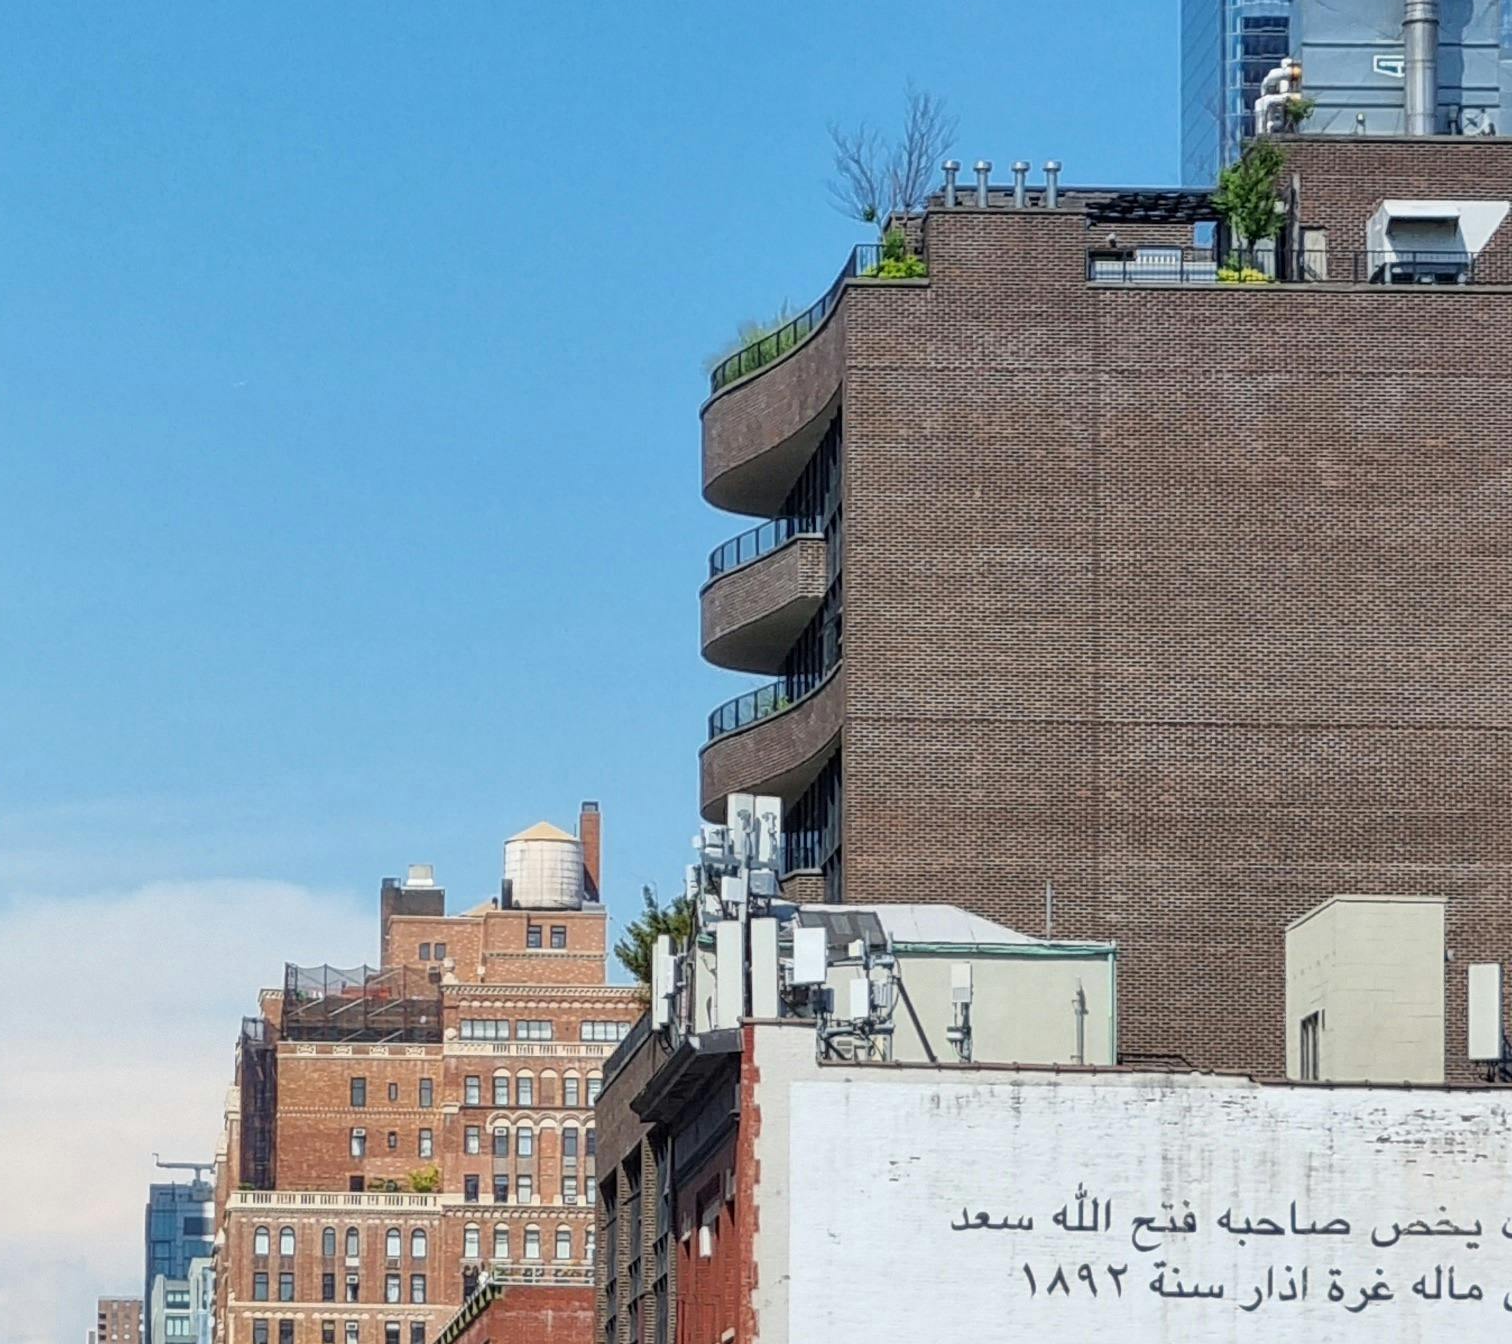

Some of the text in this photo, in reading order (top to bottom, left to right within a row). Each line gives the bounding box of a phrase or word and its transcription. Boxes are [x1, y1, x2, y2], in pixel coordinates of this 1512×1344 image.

[950, 1207, 1034, 1232] سعد
[1131, 1199, 1197, 1253] فتح
[1216, 1199, 1351, 1247] صاحبه
[1370, 1205, 1482, 1250] يخص
[1022, 1262, 1128, 1298] ١٨٩٢
[1149, 1260, 1225, 1299] سنة
[1327, 1267, 1395, 1313] غرة
